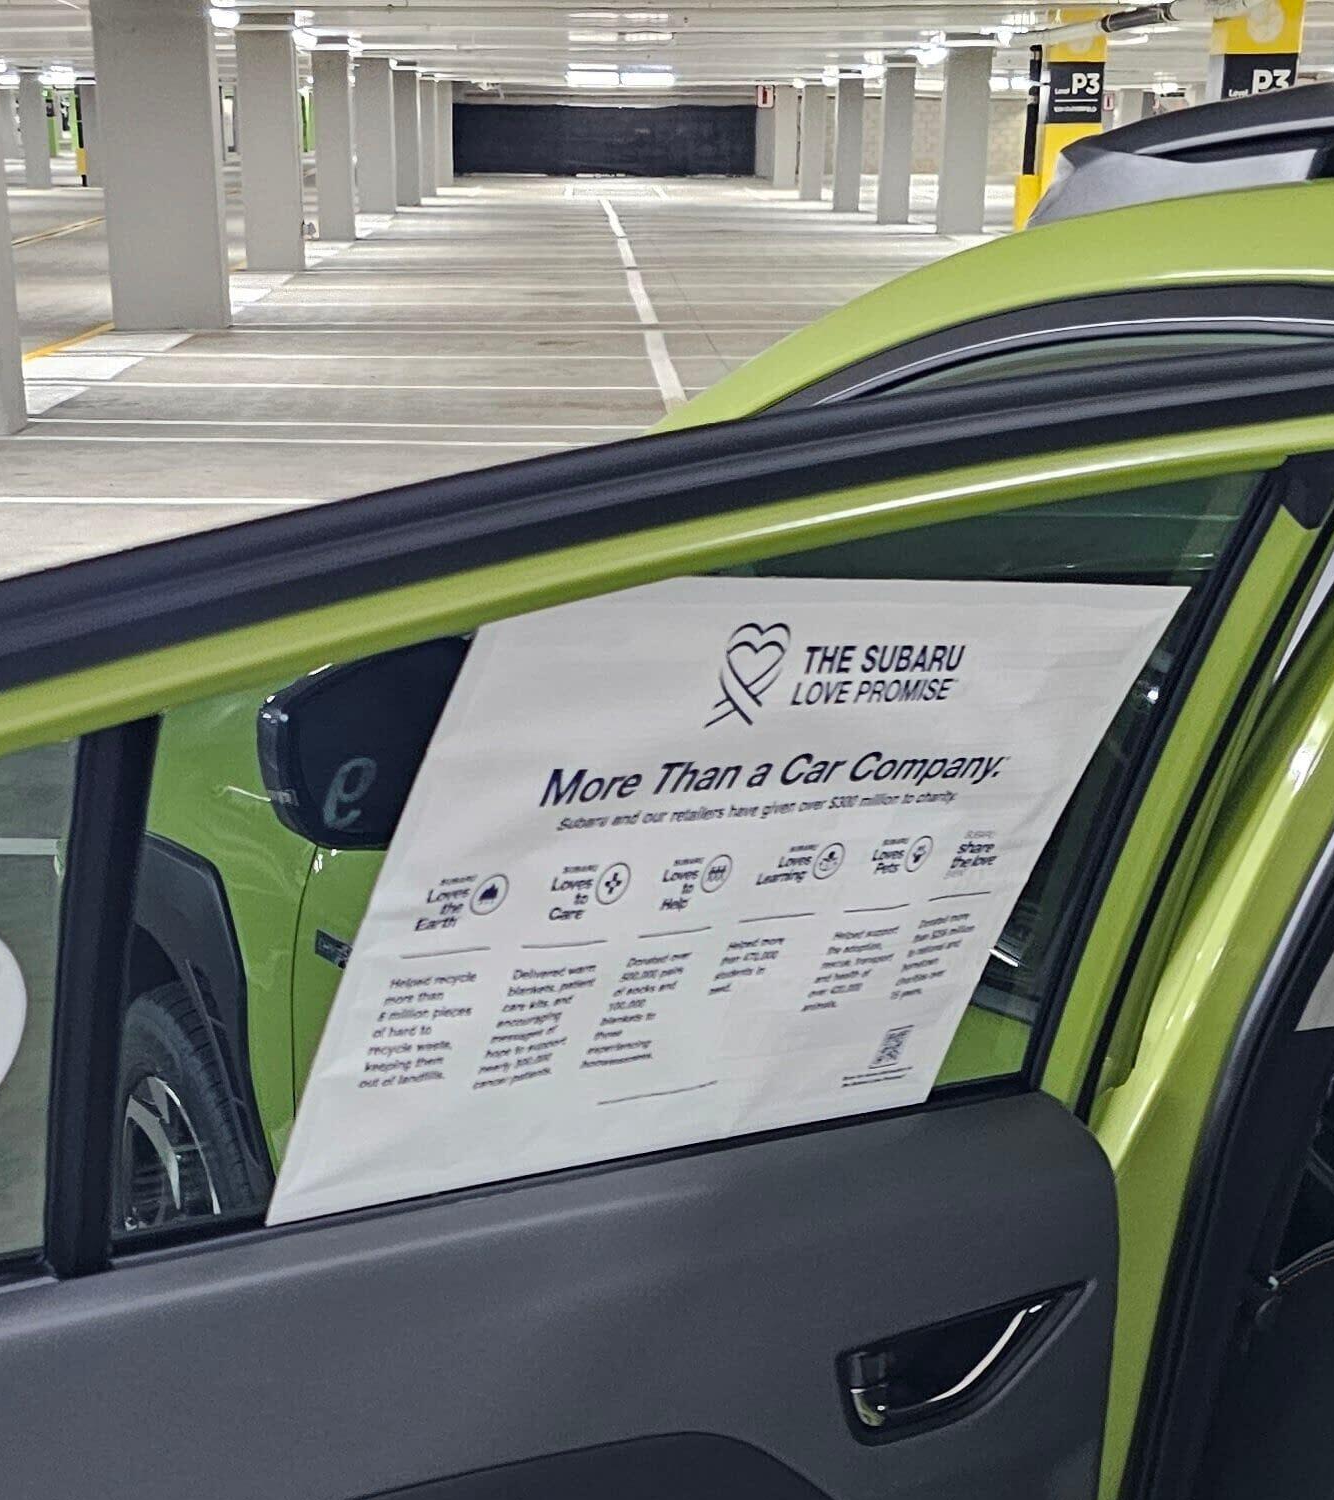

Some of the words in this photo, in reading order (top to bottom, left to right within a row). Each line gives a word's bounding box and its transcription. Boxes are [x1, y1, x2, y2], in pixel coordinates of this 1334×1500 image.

[1071, 72, 1100, 94] P3
[1252, 69, 1292, 94] P3
[803, 645, 854, 675] THE
[861, 644, 965, 674] SUBARU
[790, 680, 853, 707] LOVE
[855, 678, 955, 705] PROMISE
[540, 768, 643, 807] More
[653, 757, 738, 795] Than
[747, 761, 773, 787] a
[781, 751, 846, 786] Car
[557, 816, 609, 832] Subaru
[611, 810, 639, 827] and
[642, 810, 666, 825] our
[670, 807, 725, 824] retailers
[728, 803, 758, 820] have
[762, 802, 795, 820] given
[798, 799, 826, 814] over
[861, 793, 901, 808] million
[955, 841, 996, 854] share
[777, 855, 813, 869] Loves
[871, 848, 905, 863] Loves
[950, 856, 972, 870] the
[973, 854, 999, 867] love
[873, 862, 901, 875] Pets
[661, 869, 700, 883] Loves
[755, 869, 809, 886] Learning
[550, 878, 594, 892] Loves
[681, 883, 695, 895] to
[425, 887, 471, 904] Loves
[573, 893, 590, 906] to
[438, 902, 464, 916] the
[659, 898, 691, 912] Help
[548, 907, 586, 922] Care
[414, 916, 458, 932] Earth
[434, 972, 477, 986] recycle
[383, 995, 414, 1006] more
[432, 1006, 473, 1020] pieces
